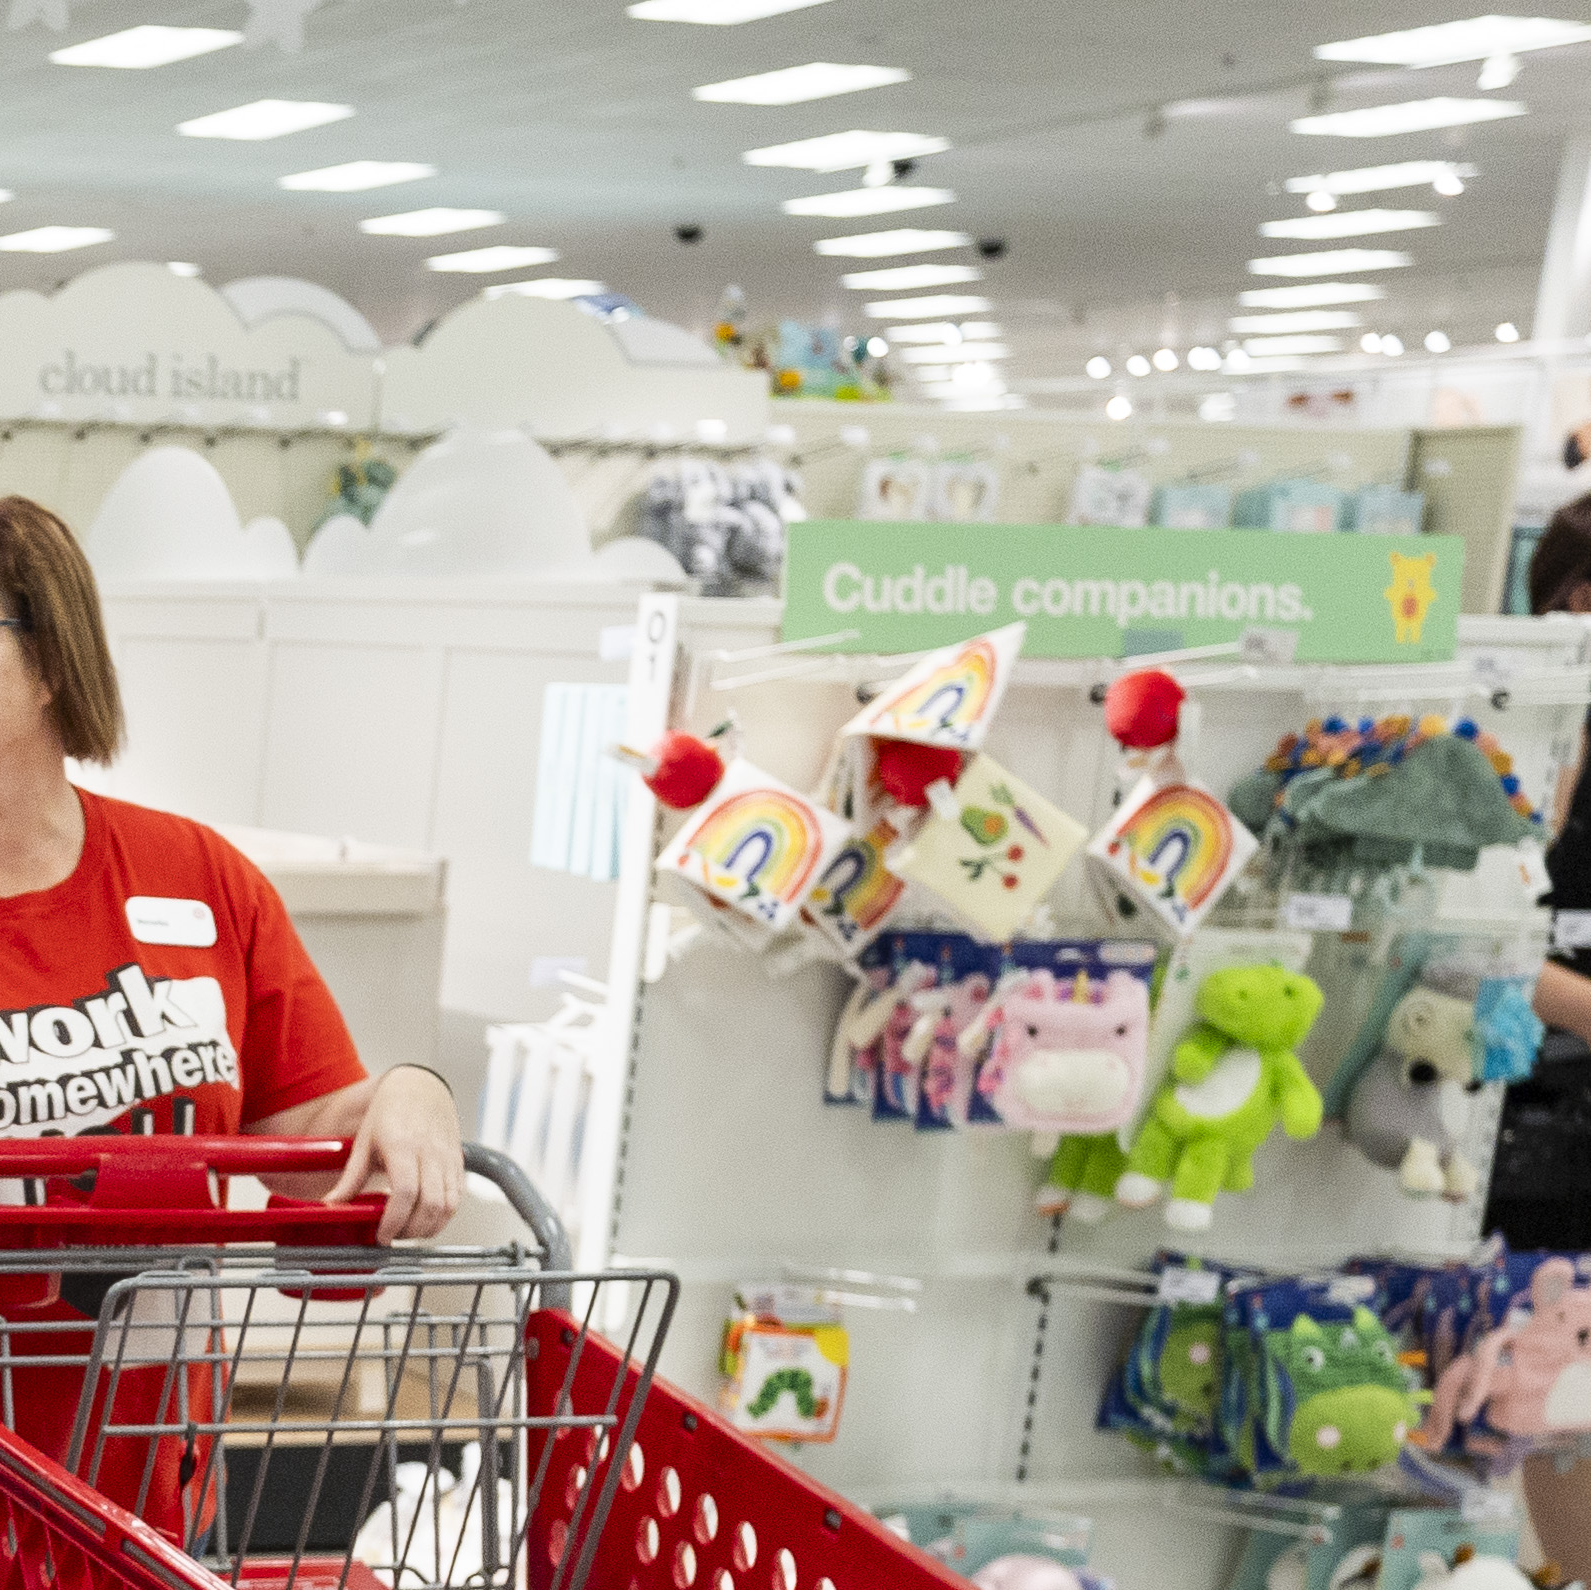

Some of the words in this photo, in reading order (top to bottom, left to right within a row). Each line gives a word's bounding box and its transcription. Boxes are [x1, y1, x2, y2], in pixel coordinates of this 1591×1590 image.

[37, 347, 159, 398] cloud
[169, 350, 302, 401] island
[822, 561, 998, 616] Cuddle
[1010, 570, 1314, 628] companions.
